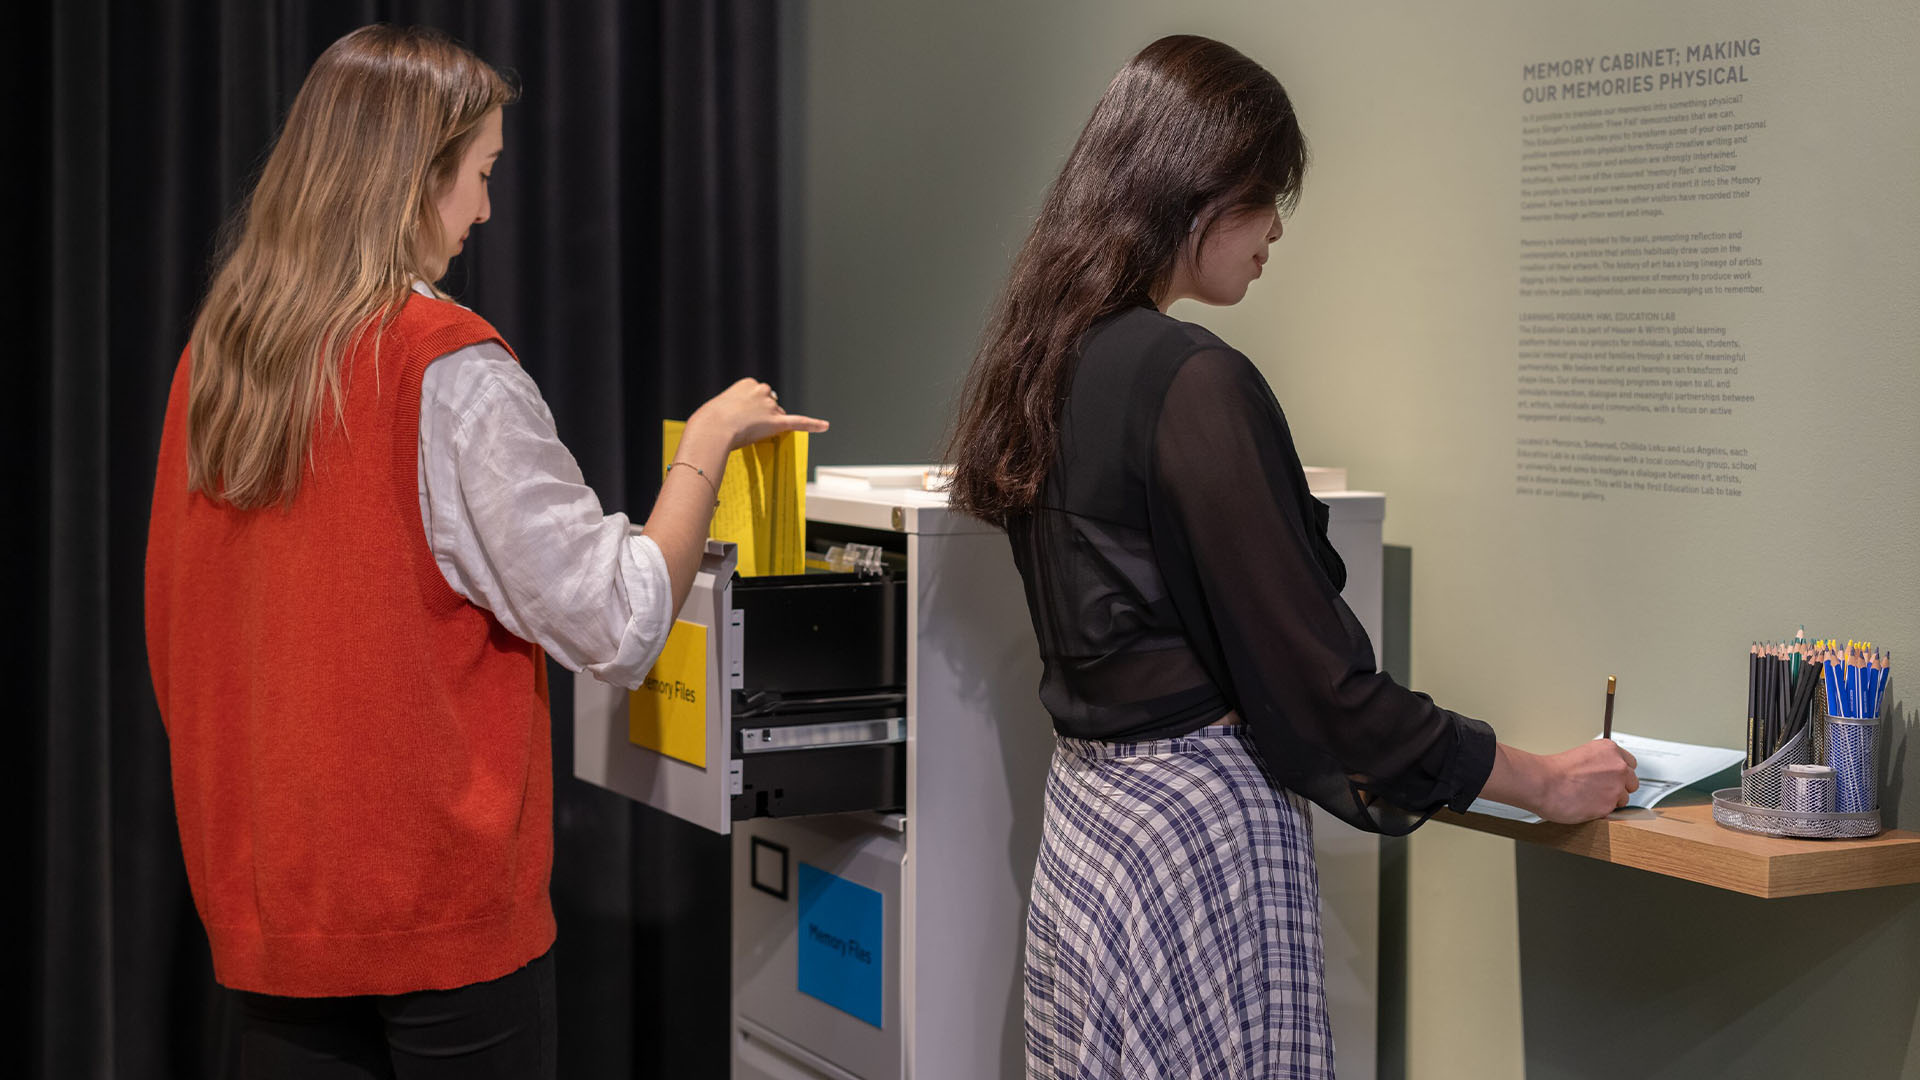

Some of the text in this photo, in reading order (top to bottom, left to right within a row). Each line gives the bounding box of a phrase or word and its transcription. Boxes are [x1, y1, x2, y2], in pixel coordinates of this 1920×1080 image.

[1523, 38, 1760, 81] MEMORY CABINET; MAKING
[1523, 65, 1748, 104] OUR MEMORIES PHYSICAL
[1708, 95, 1742, 107] physical?
[1734, 120, 1766, 132] personal
[1706, 136, 1731, 147] writing
[1734, 135, 1747, 144] and
[1693, 149, 1737, 160] intertwined.
[1713, 163, 1735, 172] follow
[1717, 177, 1728, 185] the
[1731, 175, 1761, 186] Memory
[1698, 190, 1730, 200] recorded
[1732, 189, 1749, 198] their
[1728, 230, 1742, 239] and
[1700, 246, 1718, 255] upon
[1720, 245, 1726, 253] in
[1729, 244, 1741, 253] the
[1700, 258, 1726, 268] lineage
[1729, 258, 1736, 266] of
[1738, 257, 1762, 266] artists
[1701, 271, 1730, 281] produce
[1733, 271, 1750, 279] work
[1715, 285, 1722, 293] to
[1724, 285, 1763, 293] remember.
[1696, 325, 1726, 335] learning
[1706, 339, 1740, 348] students,
[1704, 352, 1745, 362] meaningful
[1724, 366, 1738, 374] and
[1716, 379, 1730, 388] and
[1722, 393, 1754, 402] between
[1710, 406, 1731, 415] active
[1697, 445, 1727, 456] Angeles,
[1730, 447, 1747, 456] each
[1706, 461, 1729, 470] group,
[1732, 460, 1756, 470] school
[1701, 472, 1713, 482] art,
[1716, 473, 1741, 484] artists,
[1701, 485, 1714, 494] Lab
[1716, 486, 1723, 495] to
[1725, 487, 1741, 496] take
[646, 677, 696, 702] emory Files
[808, 922, 871, 965] Memory Files
